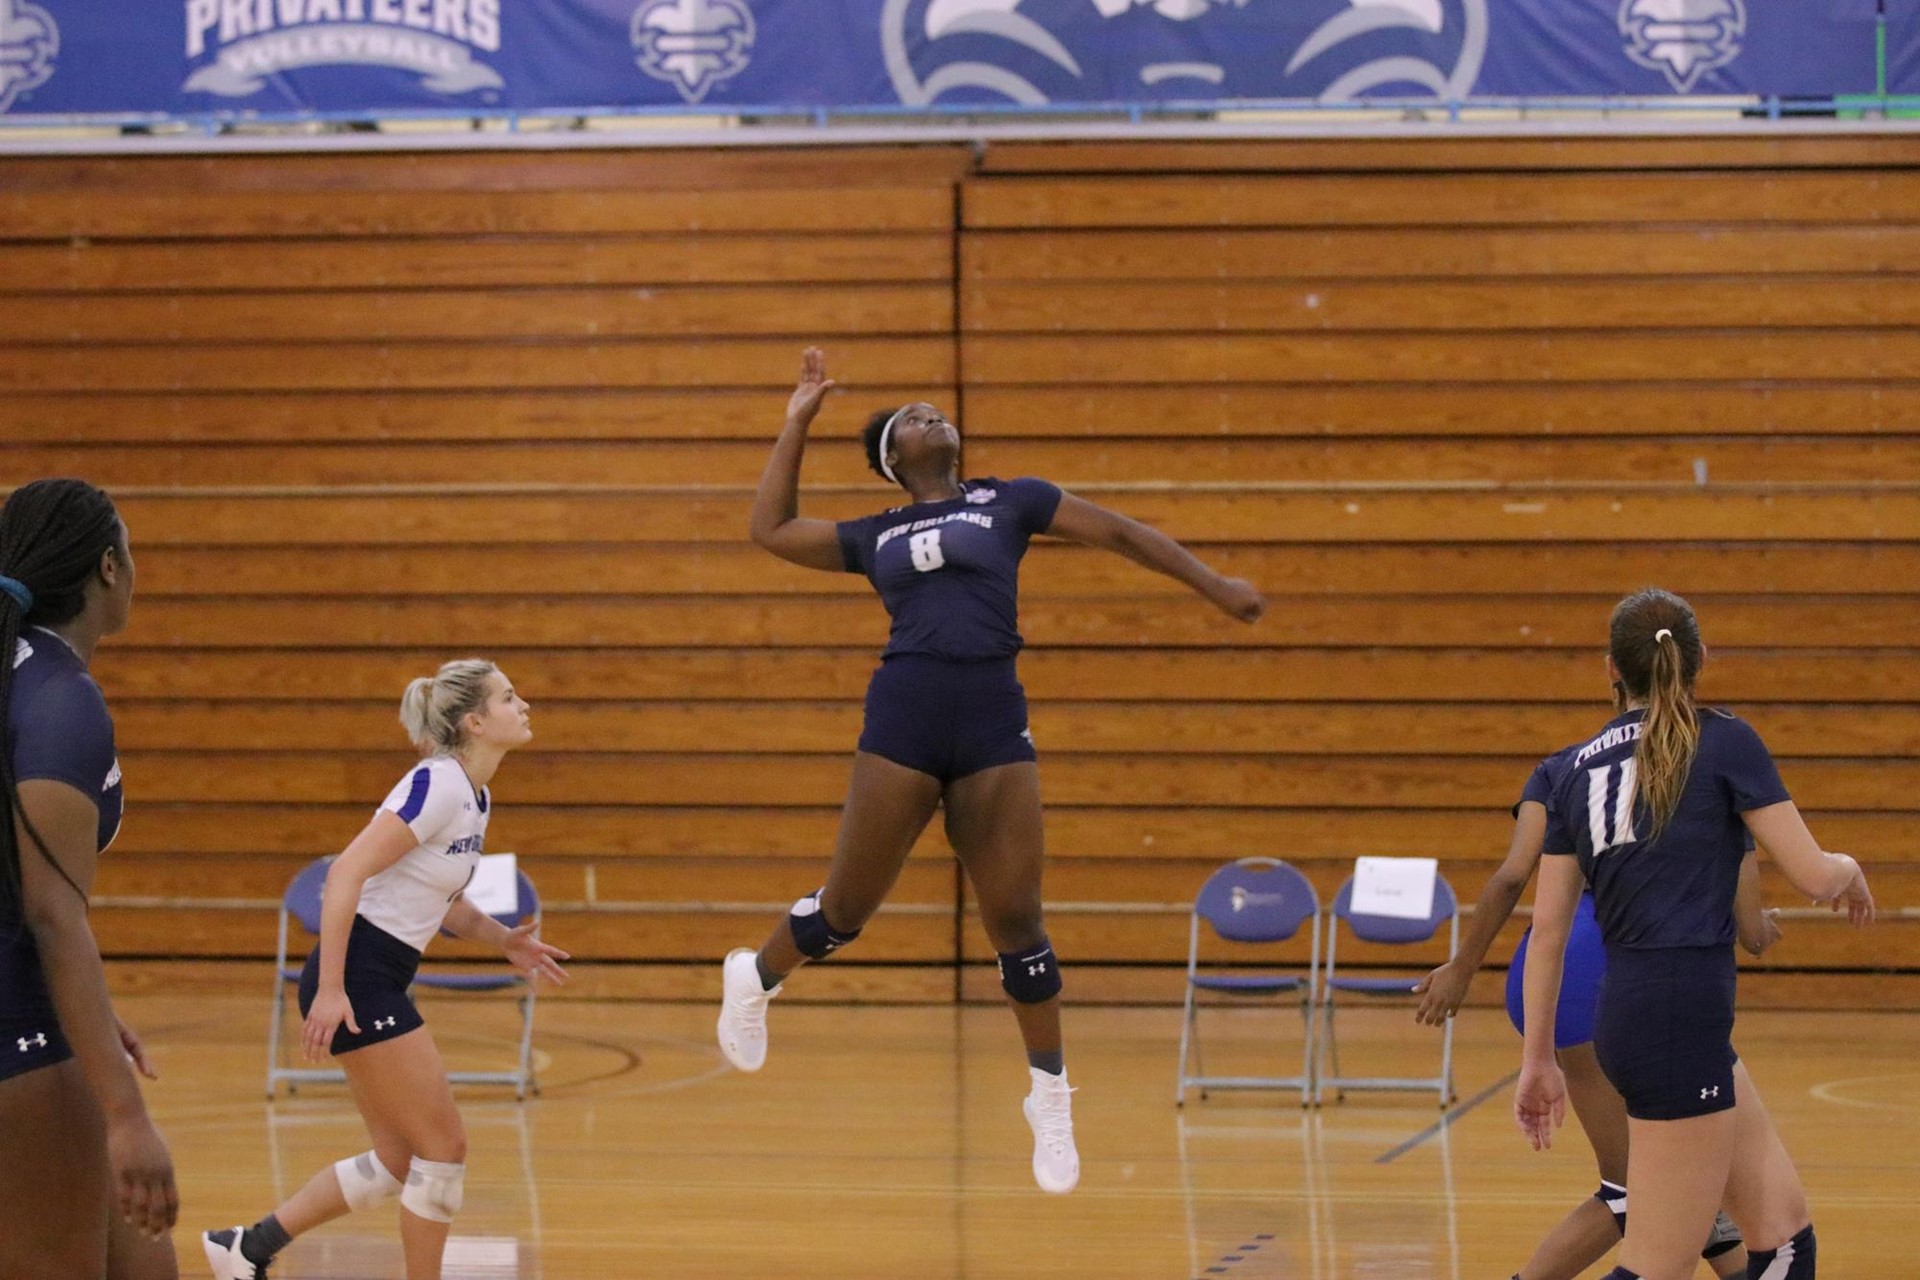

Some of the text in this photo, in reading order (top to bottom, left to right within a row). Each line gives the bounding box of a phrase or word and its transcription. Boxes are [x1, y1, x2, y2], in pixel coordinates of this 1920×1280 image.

[223, 31, 459, 72] VOLLEYBALL
[876, 512, 993, 552] NEW ORLEANS
[909, 528, 945, 572] 8
[1587, 756, 1638, 857] 11
